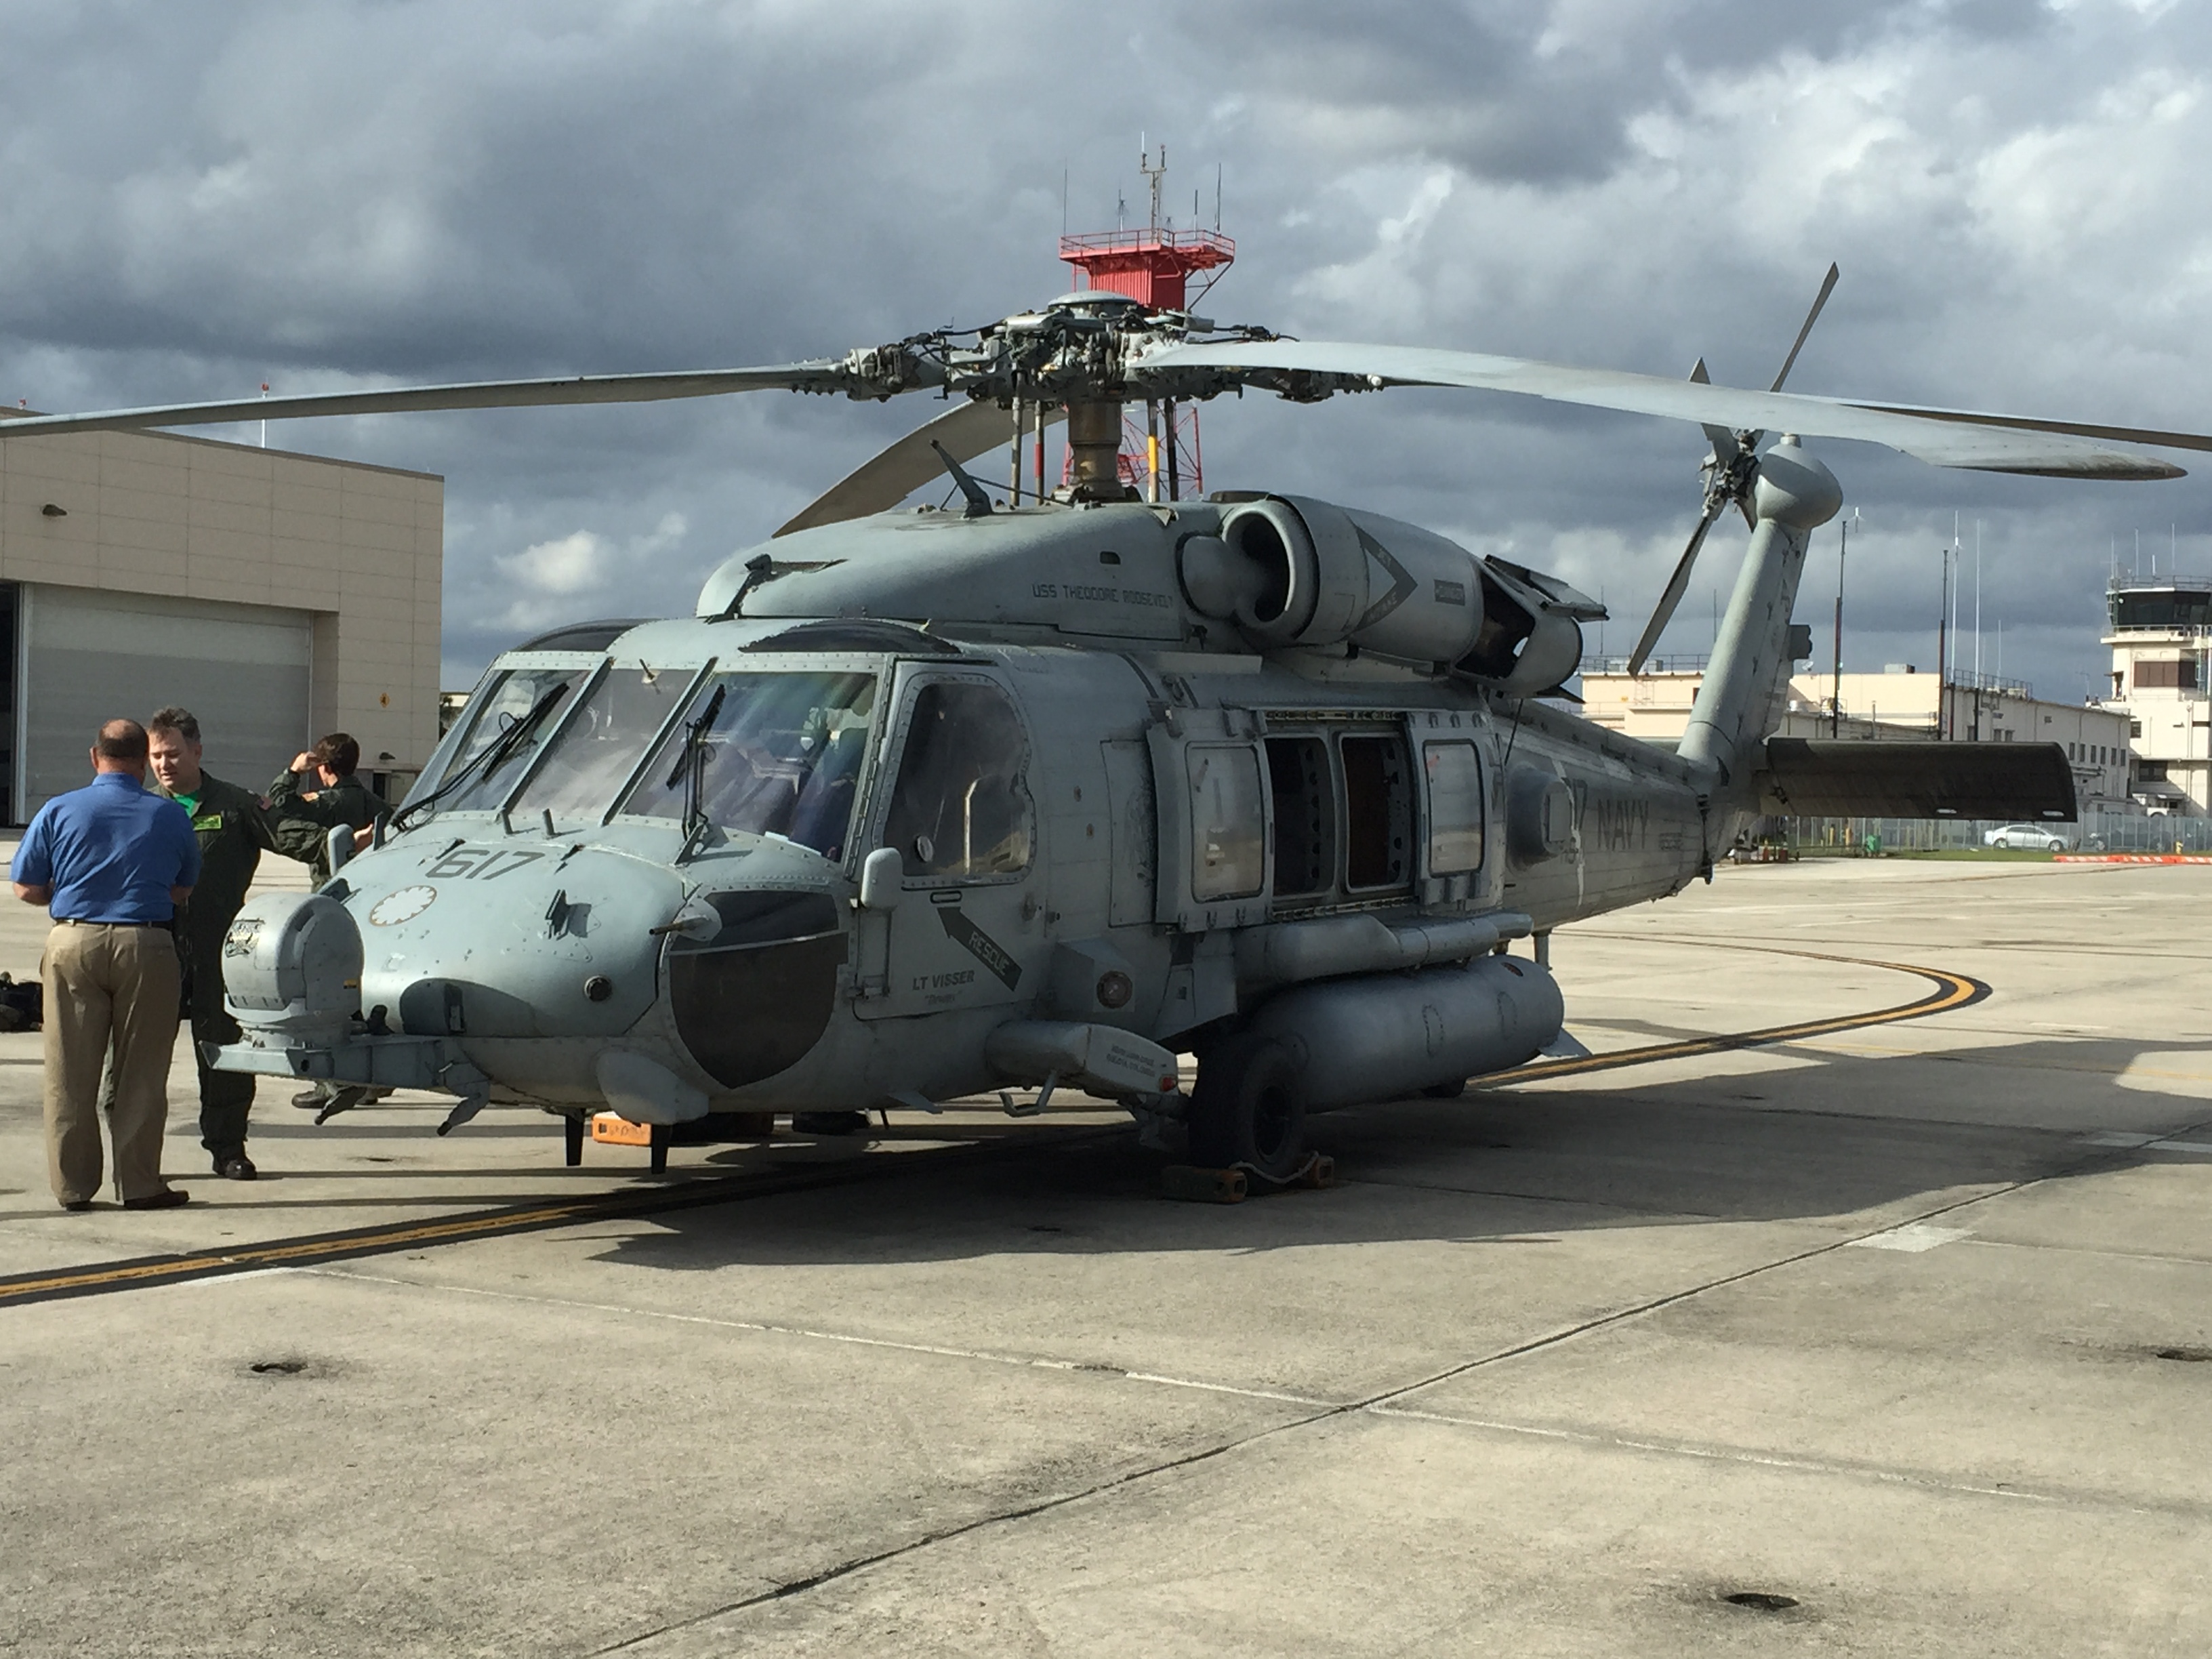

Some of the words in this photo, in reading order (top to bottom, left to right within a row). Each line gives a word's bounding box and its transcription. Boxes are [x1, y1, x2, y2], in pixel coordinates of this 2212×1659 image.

[1031, 583, 1057, 598] USS
[1062, 585, 1119, 602] THEODORE
[1597, 798, 1649, 851] NAVY
[425, 849, 546, 880] 617
[968, 931, 1010, 976] RESCUE
[912, 976, 928, 990] LT
[933, 970, 975, 988] VISSER
